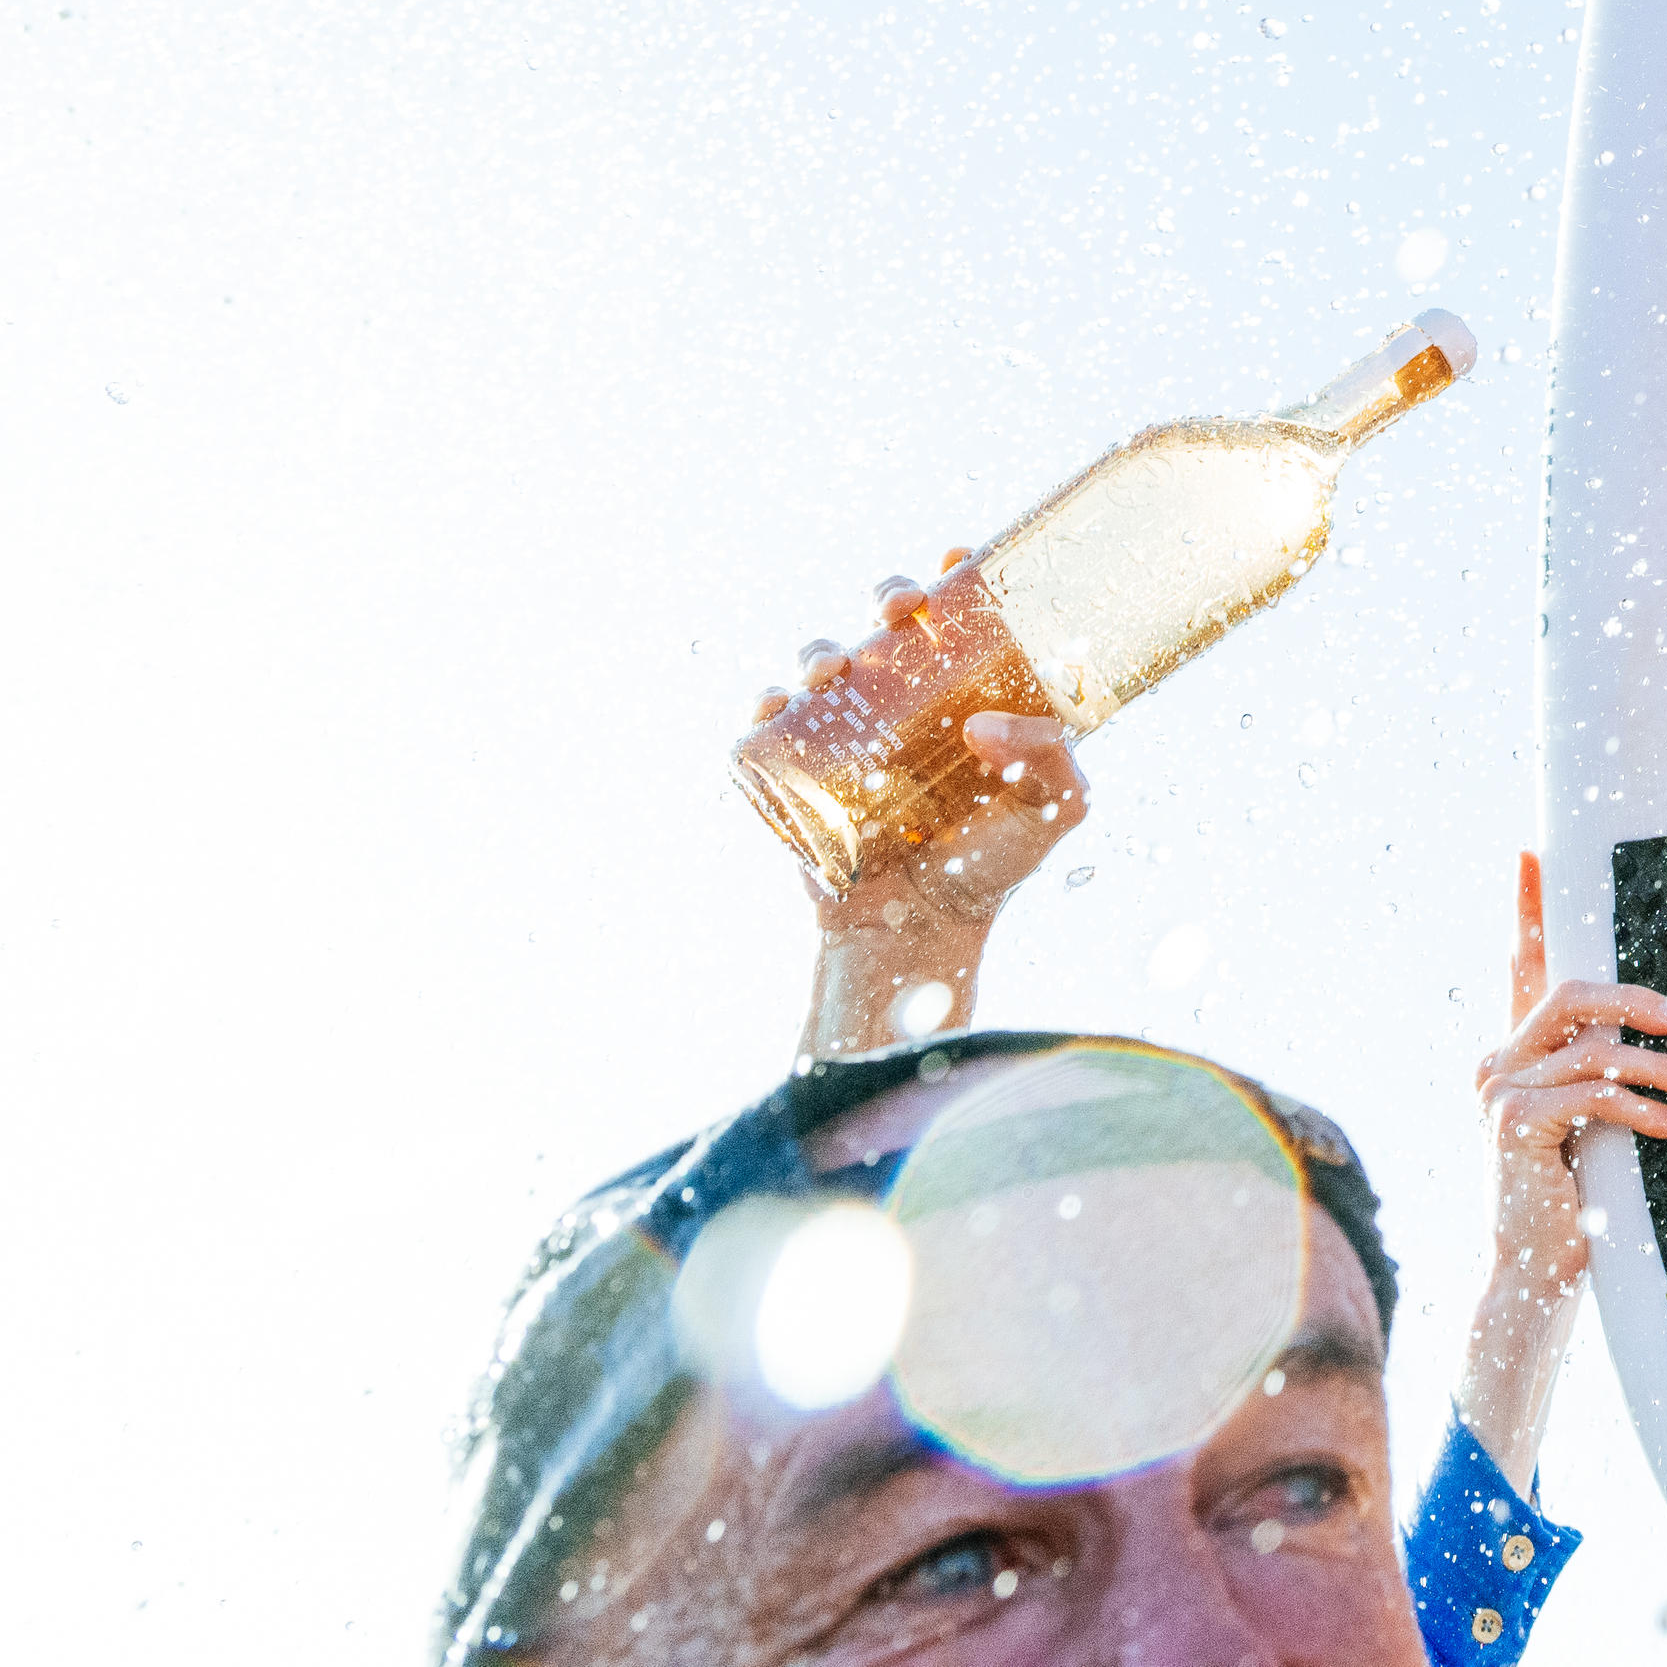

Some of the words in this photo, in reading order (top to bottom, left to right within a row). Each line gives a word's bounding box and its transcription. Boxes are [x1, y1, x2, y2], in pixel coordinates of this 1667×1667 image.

[845, 687, 872, 716] TEQUILA
[874, 719, 904, 751] BLANCO
[847, 739, 877, 771] MEXICO
